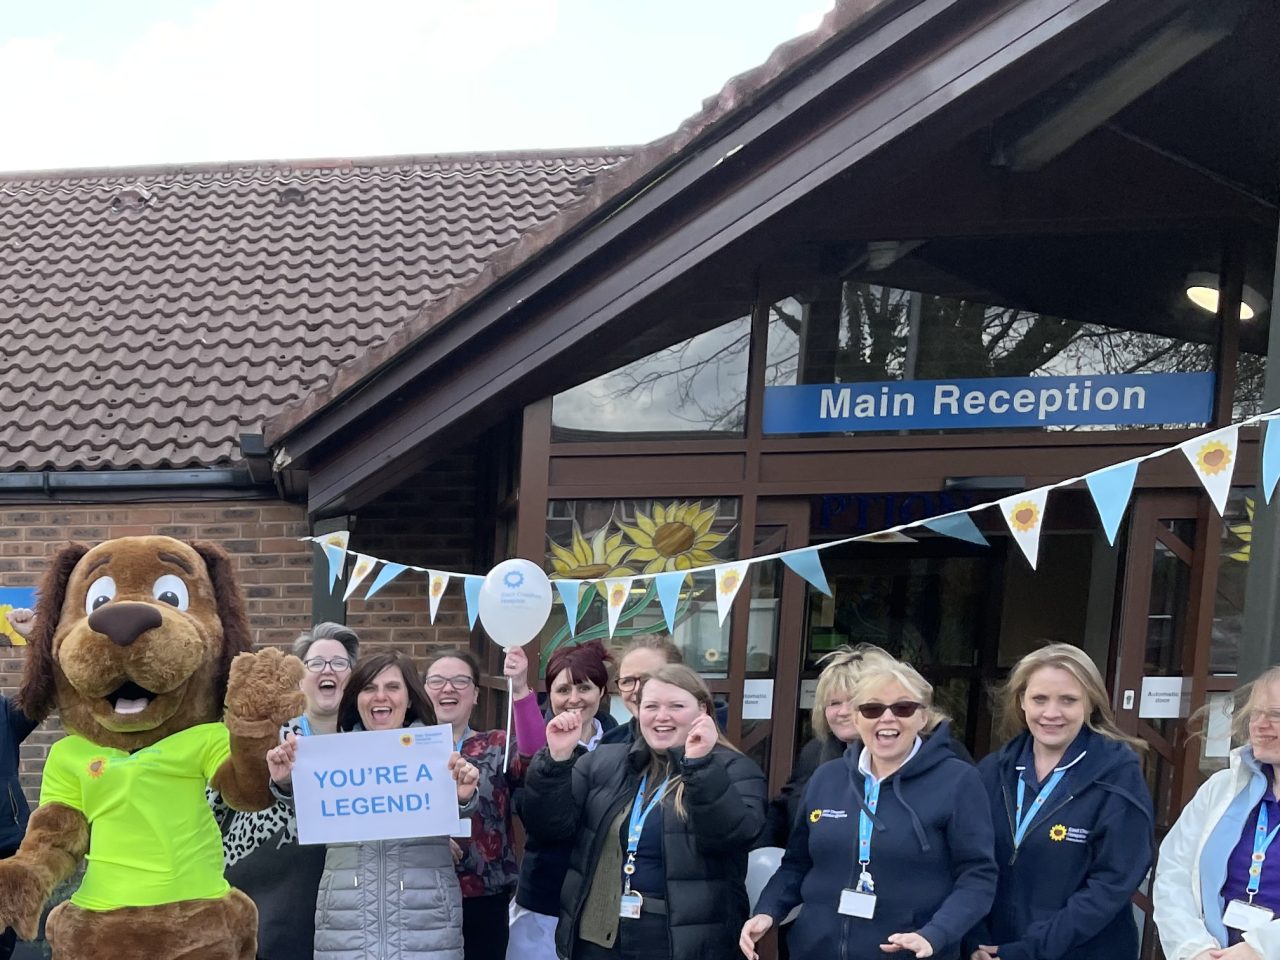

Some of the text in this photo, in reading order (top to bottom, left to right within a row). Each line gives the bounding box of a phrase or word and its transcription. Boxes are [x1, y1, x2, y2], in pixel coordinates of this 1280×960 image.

[819, 380, 1147, 420] Main Reception
[313, 764, 433, 789] YOU'RE A
[321, 793, 431, 817] LEGEND!
